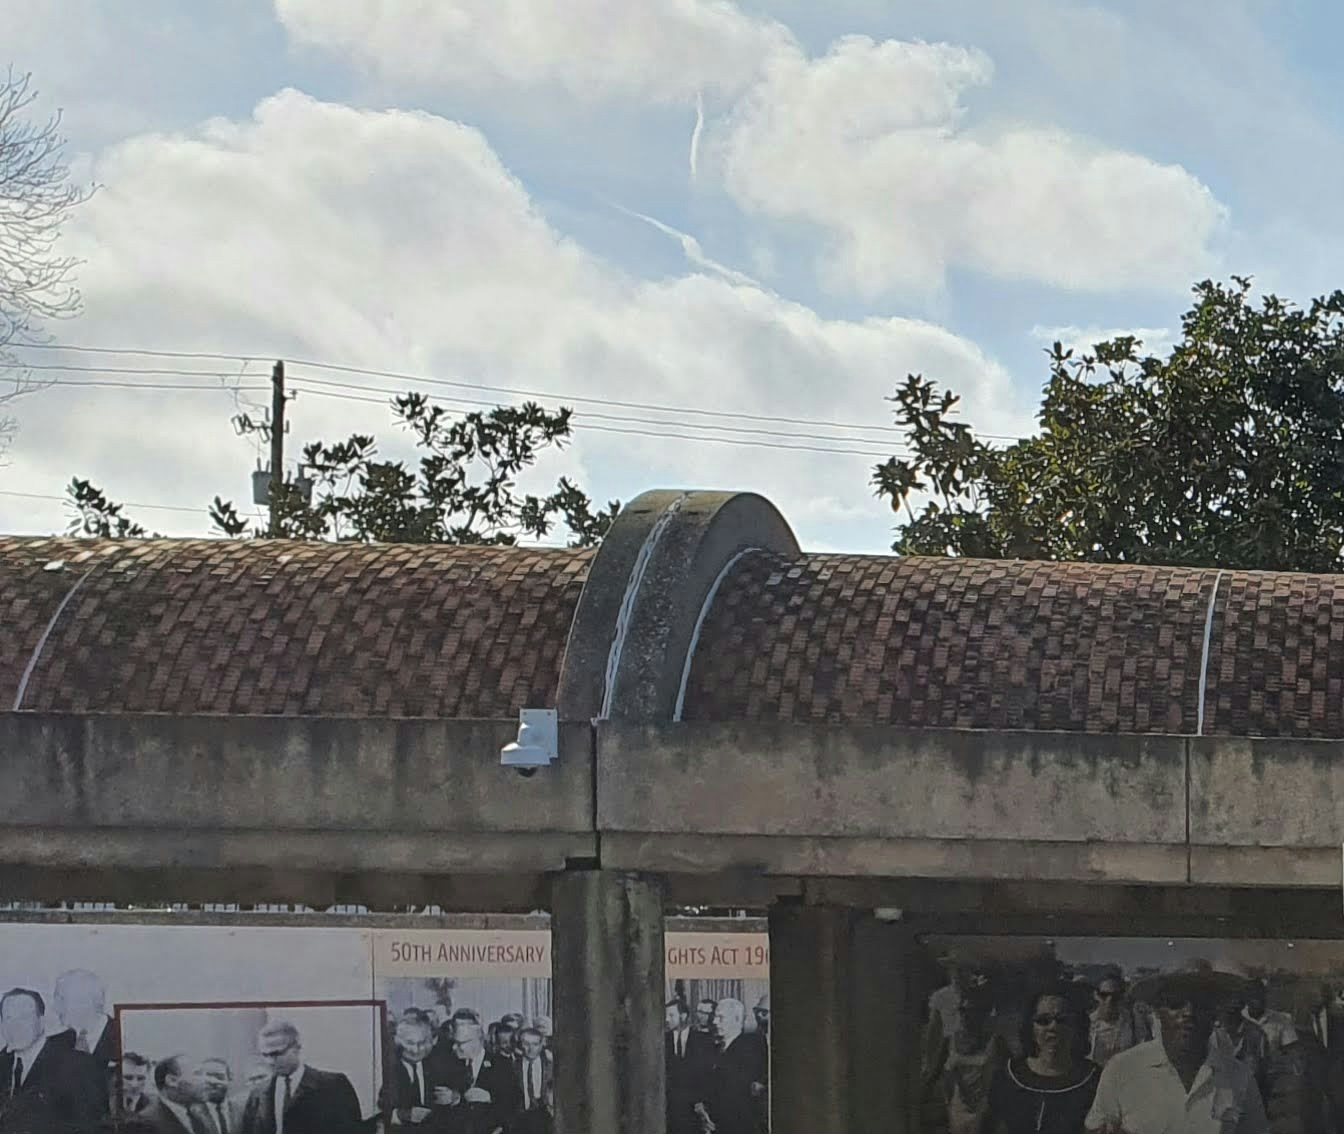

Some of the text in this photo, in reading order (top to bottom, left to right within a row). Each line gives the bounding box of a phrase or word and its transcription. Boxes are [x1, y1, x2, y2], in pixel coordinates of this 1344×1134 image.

[391, 942, 432, 963] 50TH
[437, 943, 545, 963] ANNIVERSARY
[667, 947, 706, 966] GHTS
[711, 945, 739, 966] ACT
